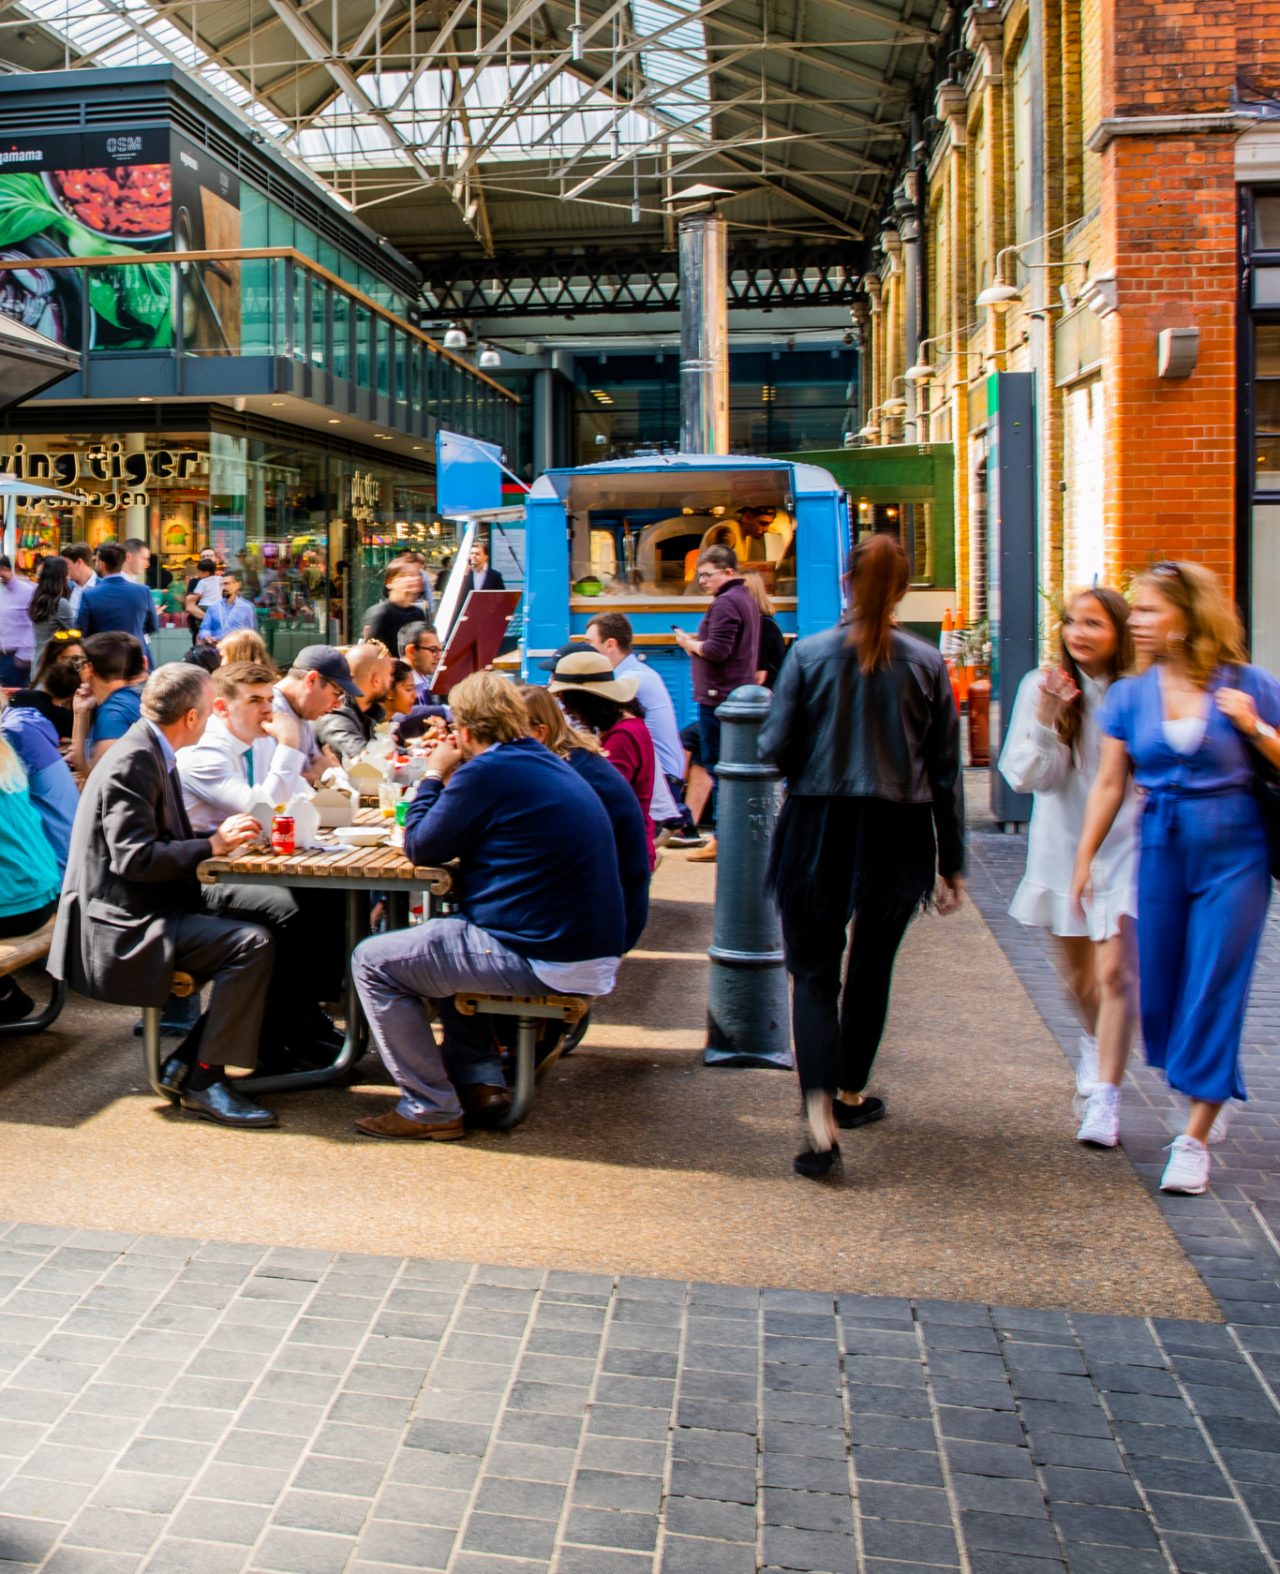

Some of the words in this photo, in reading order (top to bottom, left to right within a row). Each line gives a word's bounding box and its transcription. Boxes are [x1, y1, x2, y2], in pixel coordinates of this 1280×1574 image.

[106, 136, 142, 152] OSM
[85, 441, 200, 488] tiger
[16, 487, 149, 512] openhagen
